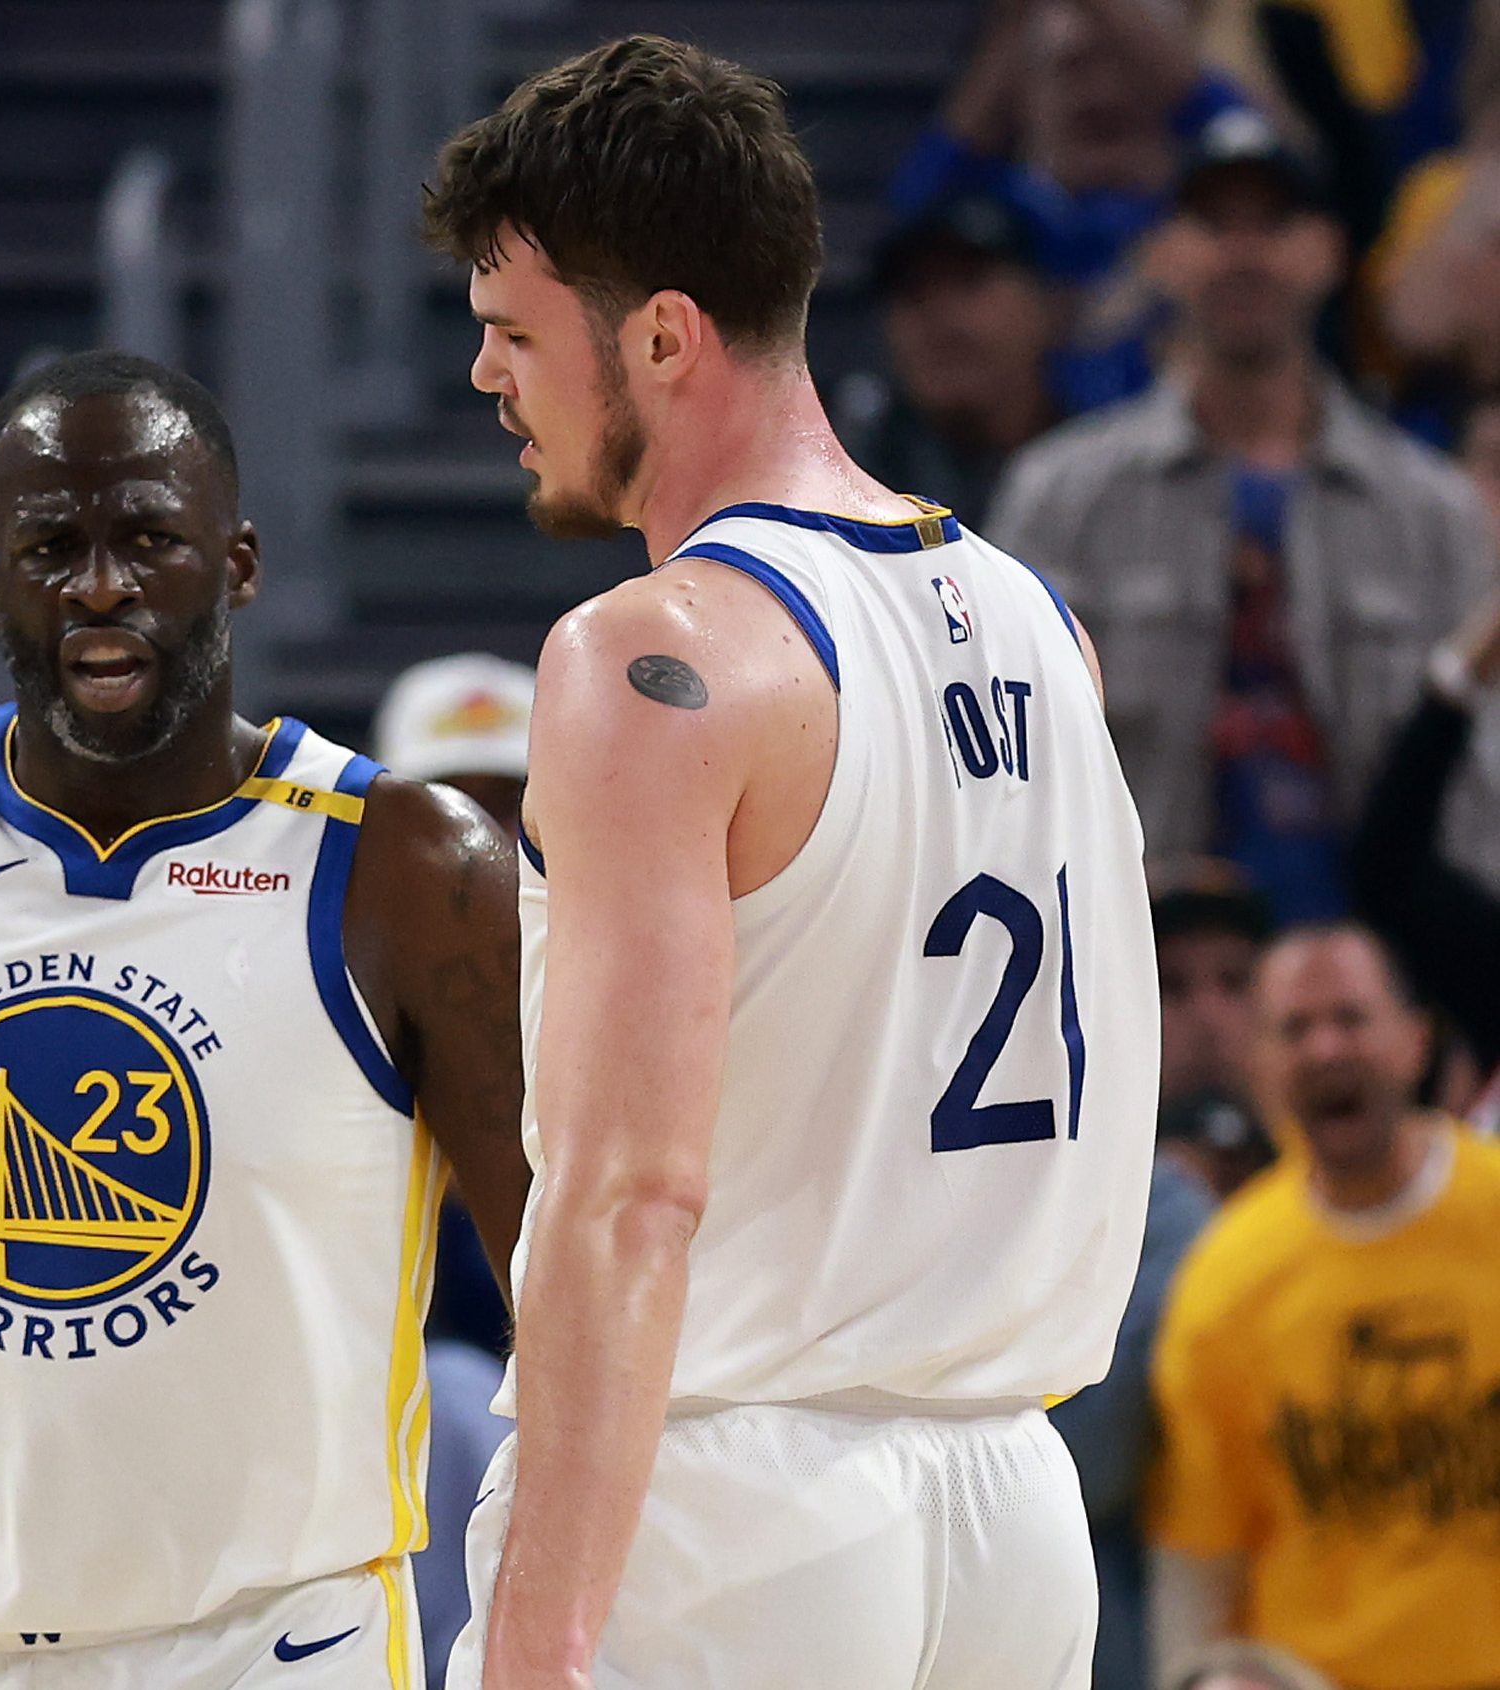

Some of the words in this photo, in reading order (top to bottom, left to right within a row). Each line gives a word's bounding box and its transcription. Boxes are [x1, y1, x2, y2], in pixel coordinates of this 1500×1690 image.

[934, 676, 1032, 789] OST
[285, 787, 315, 808] 16
[167, 862, 291, 893] Rakuten
[114, 965, 223, 1061] STATE
[71, 1070, 173, 1154] 23
